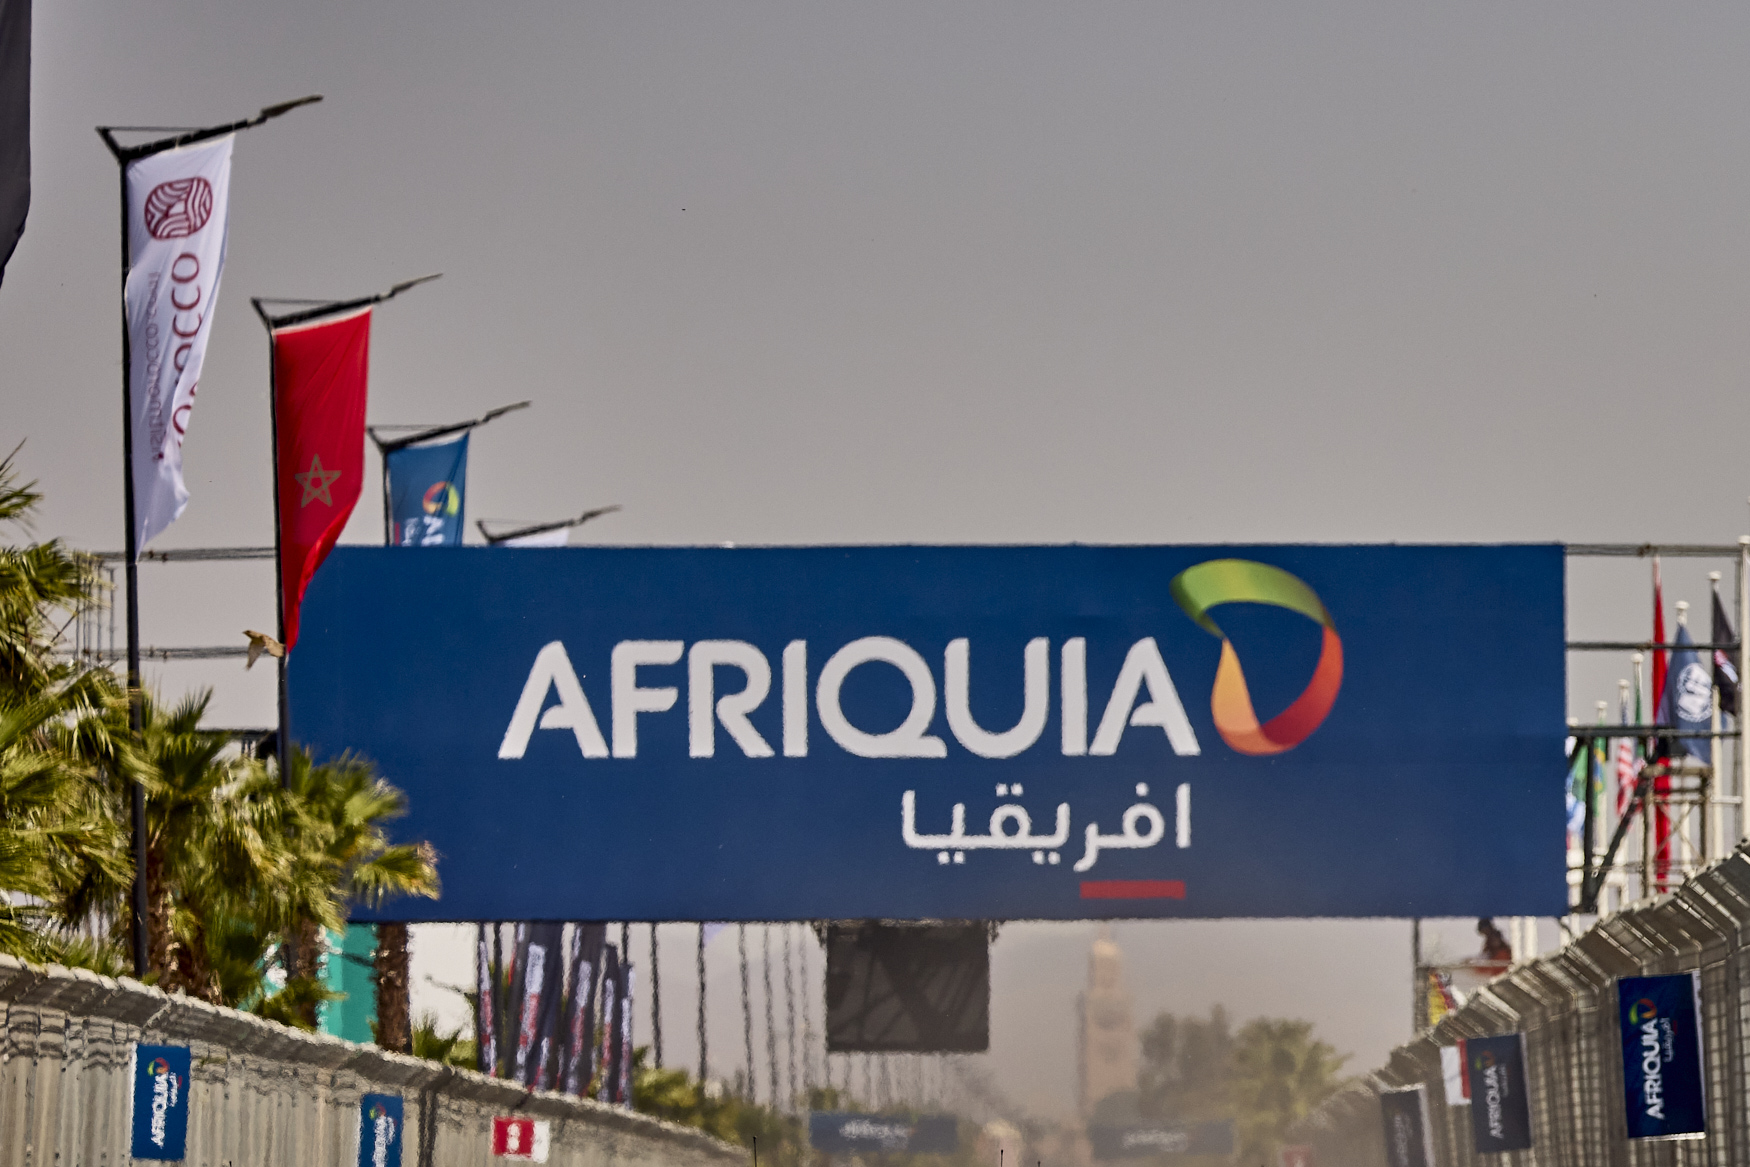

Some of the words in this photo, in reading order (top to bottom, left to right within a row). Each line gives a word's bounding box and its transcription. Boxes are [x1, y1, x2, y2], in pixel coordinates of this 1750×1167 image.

[497, 637, 1201, 760] AFRIQUIA
[901, 781, 1192, 874] افريقيا
[1640, 1018, 1665, 1120] AFRIQUIA
